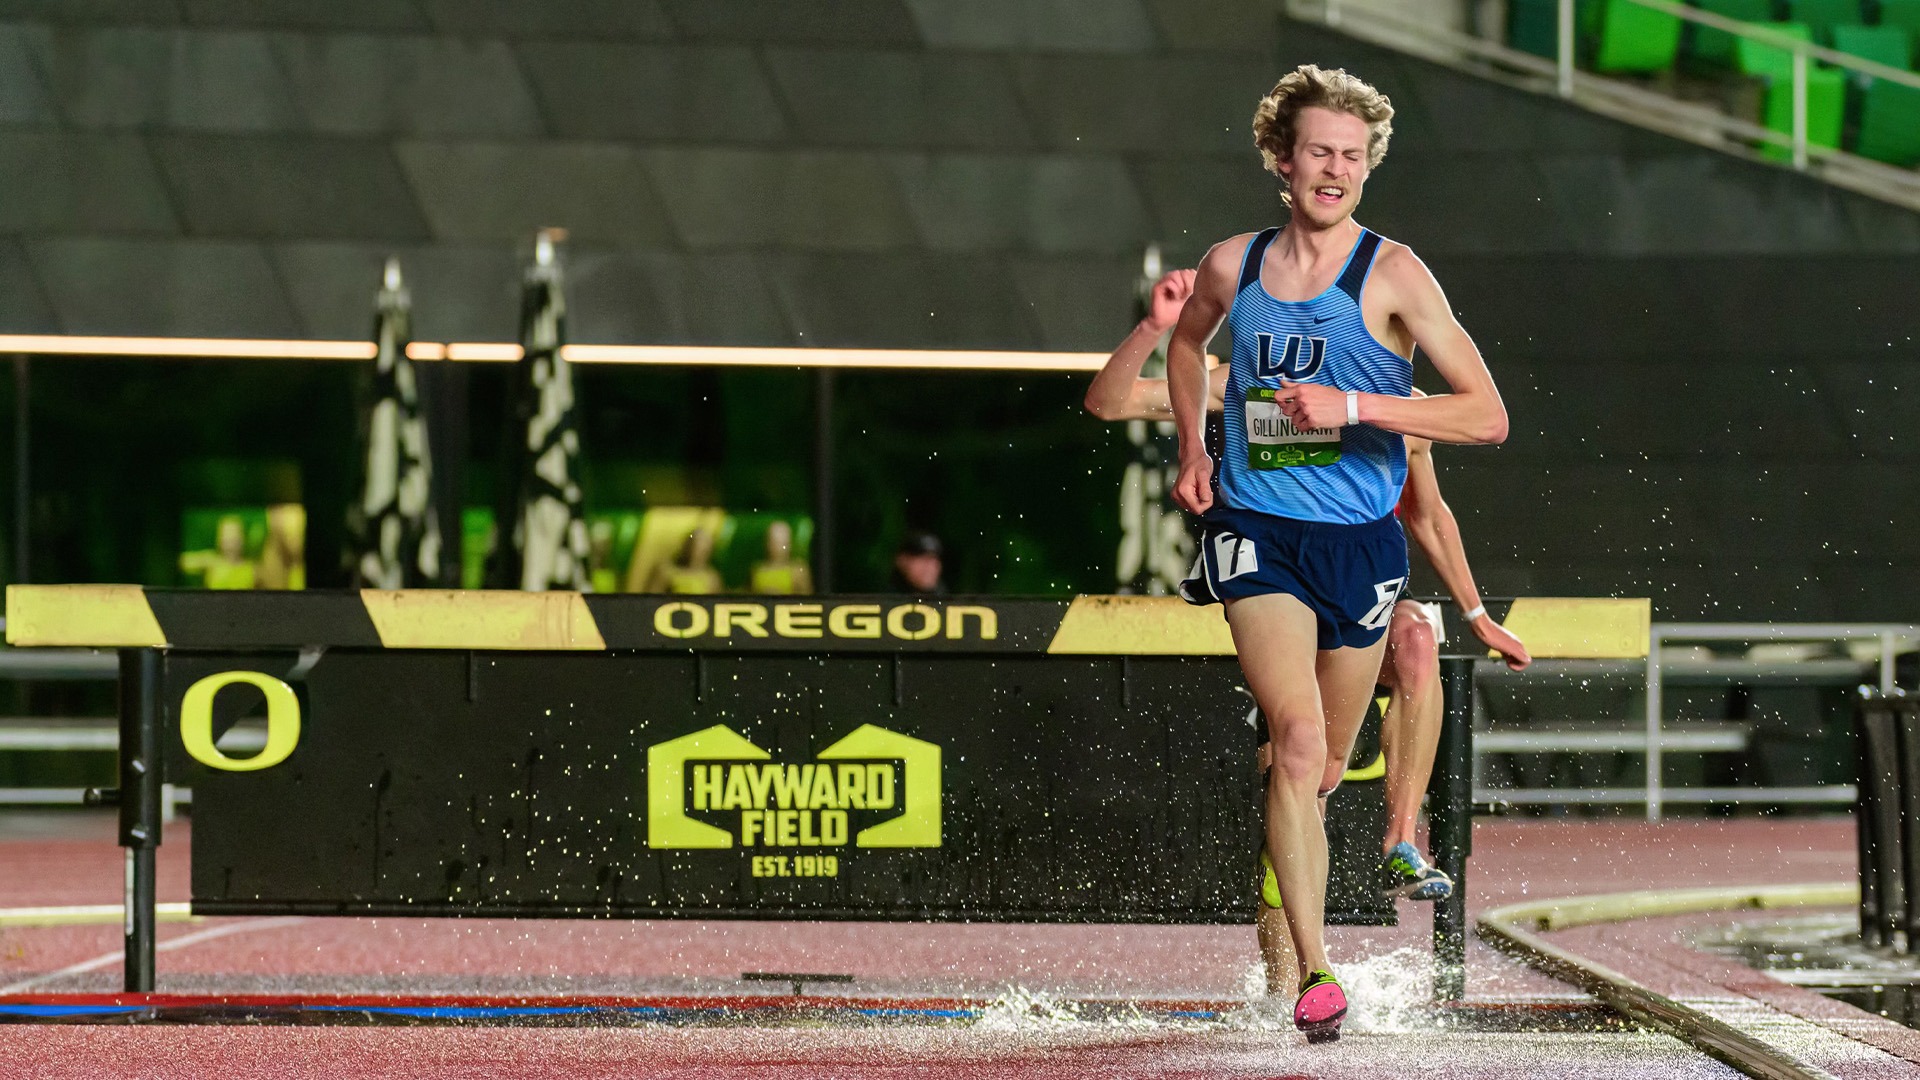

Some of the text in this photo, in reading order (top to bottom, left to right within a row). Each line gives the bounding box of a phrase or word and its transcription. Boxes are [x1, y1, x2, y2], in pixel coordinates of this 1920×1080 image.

[1253, 418, 1333, 437] GILLING
[1221, 534, 1244, 576] 7
[653, 602, 998, 640] OREGON
[1369, 582, 1399, 624] 7
[180, 670, 301, 771] O
[693, 763, 896, 810] HAYWARD
[741, 809, 848, 846] FIELD
[752, 855, 838, 877] EST. 1919
